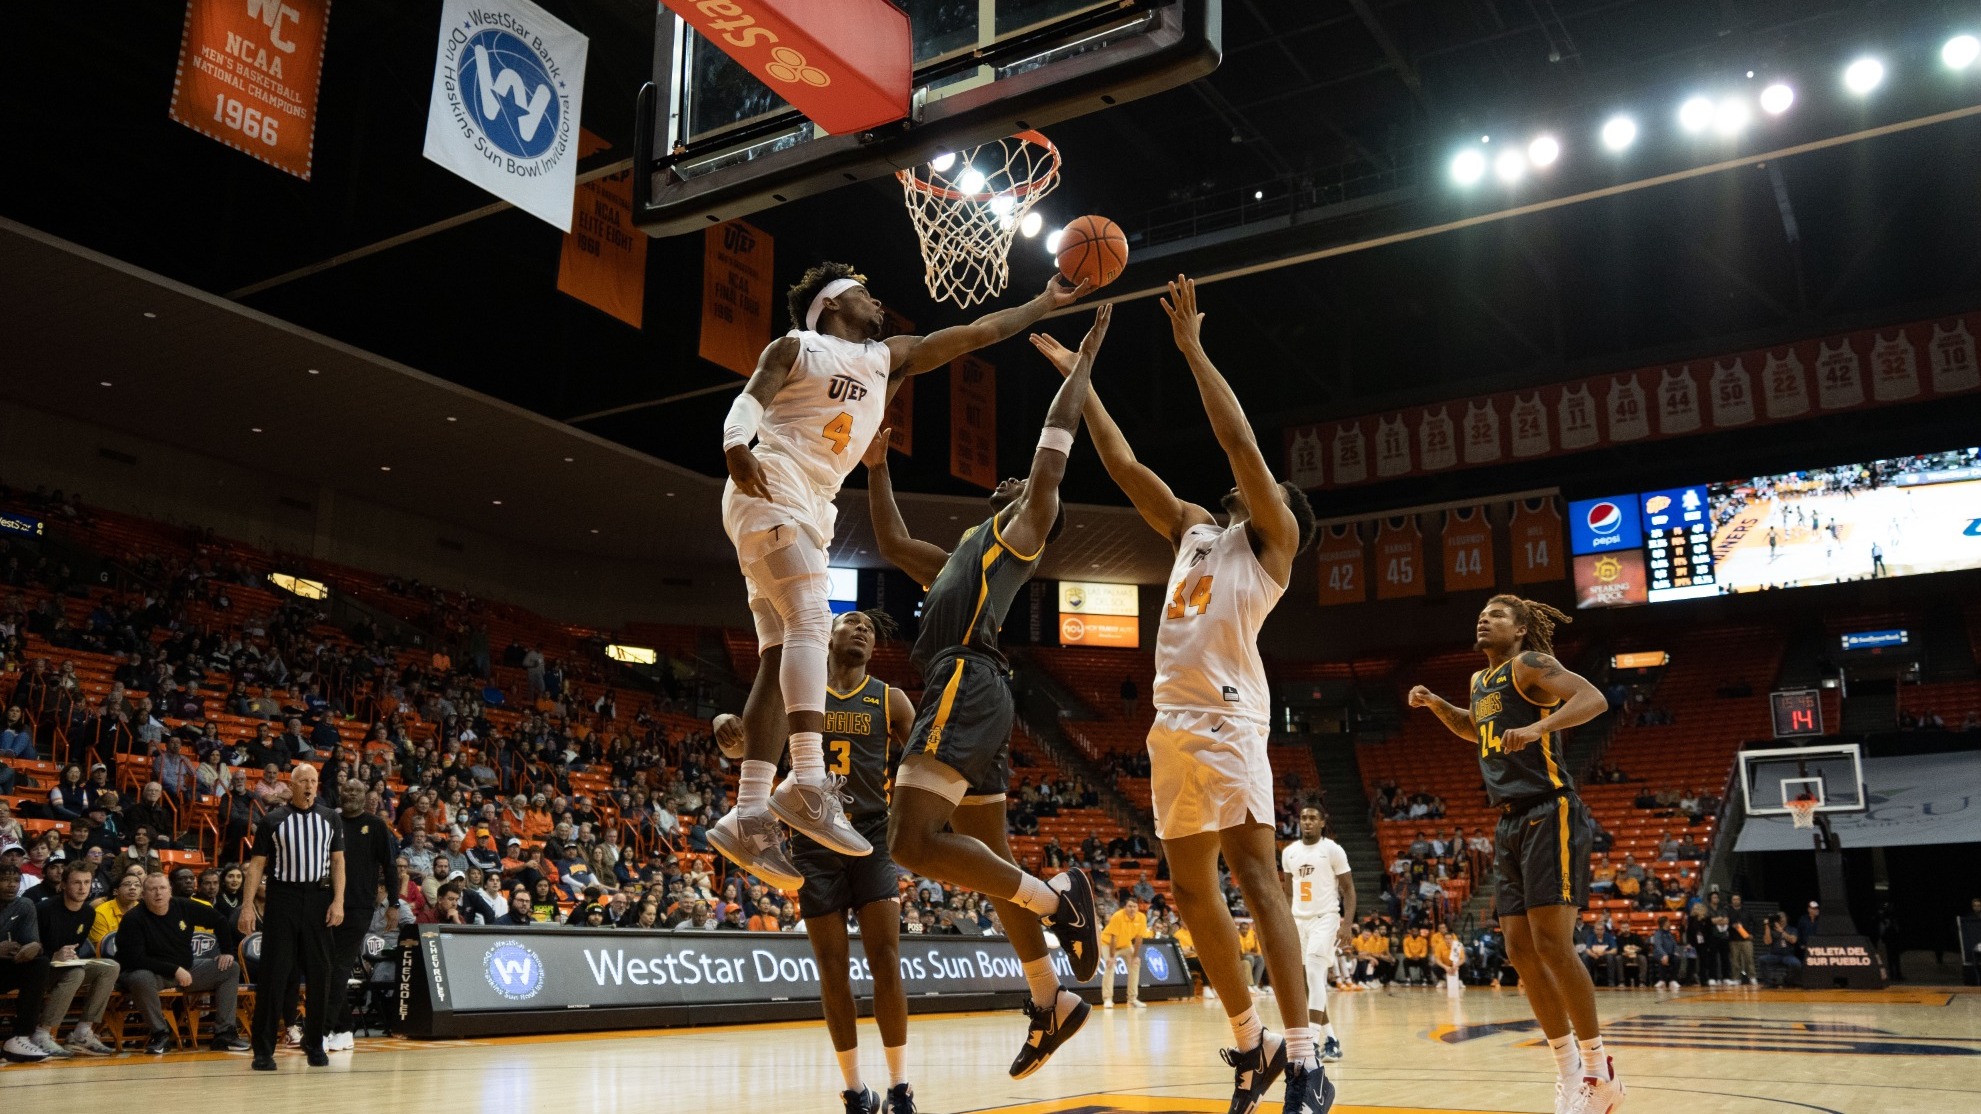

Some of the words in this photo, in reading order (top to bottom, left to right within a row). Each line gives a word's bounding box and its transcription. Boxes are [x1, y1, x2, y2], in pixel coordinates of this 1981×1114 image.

[225, 31, 283, 80] NCAA
[445, 27, 467, 62] Don
[468, 9, 530, 39] WestStar
[532, 36, 561, 79] Bank
[193, 55, 245, 91] NATIONAL
[248, 83, 307, 119] CHAMPIONS
[202, 45, 234, 70] MEN'S
[236, 63, 302, 104] BASKETBALL
[444, 65, 475, 139] Haskins
[213, 93, 279, 147] 1966
[542, 94, 570, 174] Invitational
[474, 137, 502, 168] Sun
[506, 158, 542, 178] Bowl
[724, 223, 755, 255] UTEP
[828, 374, 868, 403] UTEP
[1826, 365, 1852, 383] 42
[1666, 391, 1690, 409] 44
[1720, 383, 1744, 402] 50
[1569, 408, 1586, 425] 11
[1616, 399, 1638, 417] 40
[822, 411, 853, 455] 4
[1524, 540, 1549, 570] 14
[1592, 534, 1621, 547] pepsi
[1386, 556, 1413, 584] 45
[1455, 548, 1482, 577] 44
[1328, 564, 1355, 591] 42
[862, 696, 880, 706] CAA
[823, 711, 872, 736] GGIES
[1792, 709, 1813, 730] 14
[1480, 720, 1502, 758] 24
[829, 740, 851, 776] 3
[1300, 881, 1312, 902] 5
[908, 923, 923, 932] POSS
[1806, 956, 1827, 966] SUR
[1829, 956, 1872, 966] PUEBLO
[1807, 946, 1846, 956] YSLETA
[1847, 946, 1868, 956] DEL
[428, 940, 445, 1002] CHEVROLET
[583, 949, 745, 986] WestStar
[752, 949, 821, 983] Don
[927, 950, 975, 979] Sun
[976, 950, 1023, 979] Bow
[400, 950, 413, 1021] CHEVROLET
